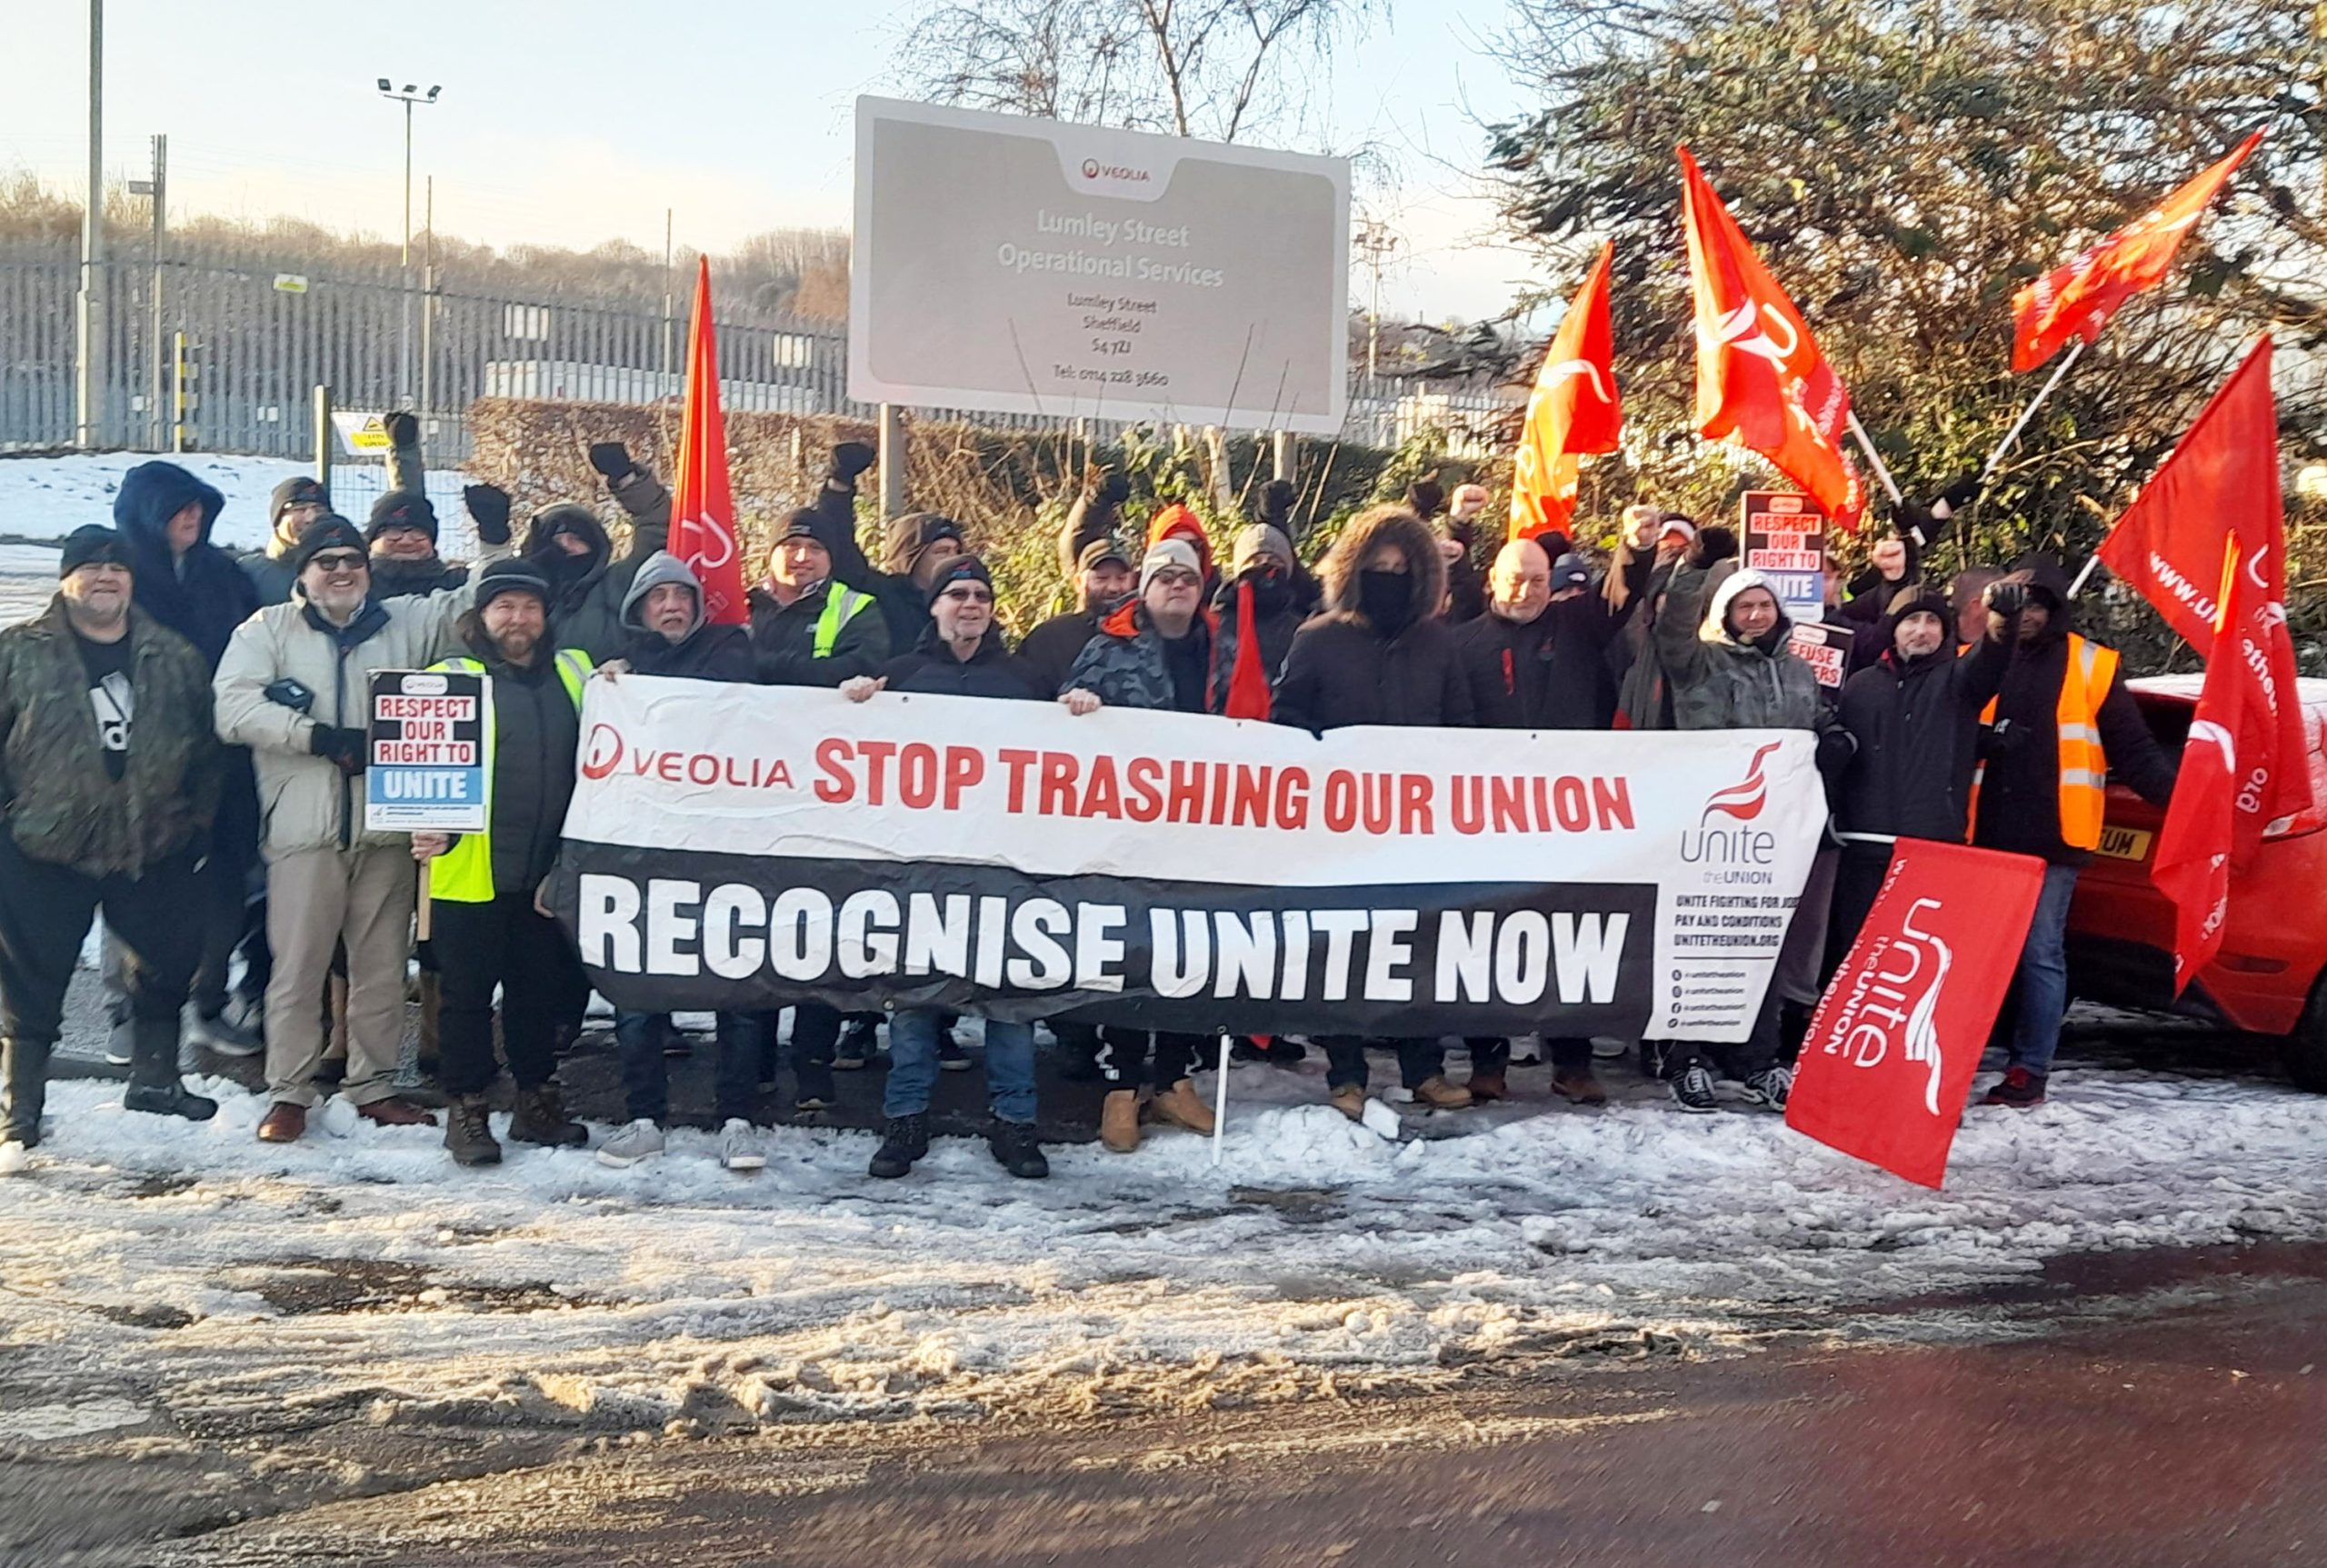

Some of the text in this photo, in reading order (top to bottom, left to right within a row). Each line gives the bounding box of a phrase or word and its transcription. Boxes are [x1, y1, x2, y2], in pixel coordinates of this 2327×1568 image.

[1102, 165, 1151, 183] VEOLIA
[1037, 209, 1190, 248] Lumley Street
[998, 243, 1224, 288] Operational Services
[1067, 292, 1157, 313] Lumley Street
[1083, 315, 1142, 334] Sheffield
[1753, 514, 1817, 532] RESPECT
[1771, 534, 1800, 549] OUR
[1753, 550, 1816, 568] RIGHT TO
[1788, 642, 1834, 665] EFUSE
[380, 698, 471, 718] RESPECT
[405, 721, 445, 740] OUR
[380, 744, 471, 763] RIGHT TO
[384, 770, 468, 799] UNITE
[634, 737, 1636, 835] VEOLIA STOP TRASHING OUR UNION
[2102, 829, 2136, 855] UM
[1676, 894, 1708, 907] UNITE
[1710, 895, 1758, 908] FIGHTING
[1761, 896, 1779, 909] FOR
[1674, 914, 1783, 928] PAY AND CONDITIONS
[578, 873, 1631, 1005] RECOGNISE UNITE NOW
[1843, 897, 1942, 1068] unite
[1823, 936, 1890, 1055] theUNION
